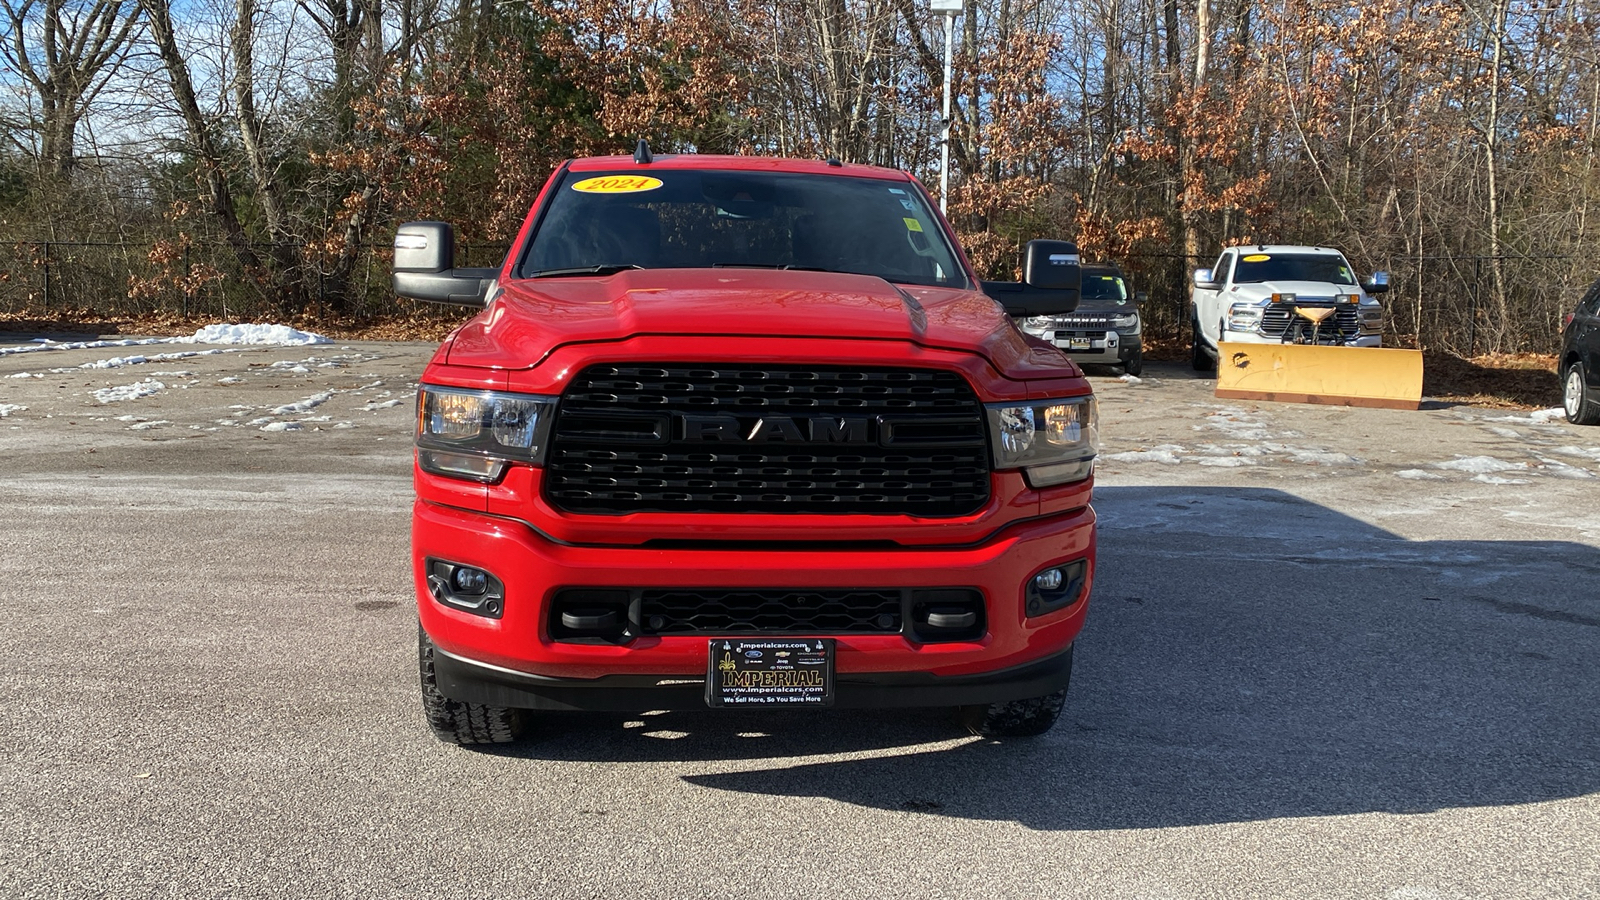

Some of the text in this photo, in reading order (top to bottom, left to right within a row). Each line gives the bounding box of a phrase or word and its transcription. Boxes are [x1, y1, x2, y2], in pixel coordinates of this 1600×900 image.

[585, 178, 649, 190] 2024
[681, 415, 868, 443] RAM
[740, 642, 807, 650] Imperialcars.com
[722, 670, 824, 687] IMPERIAL
